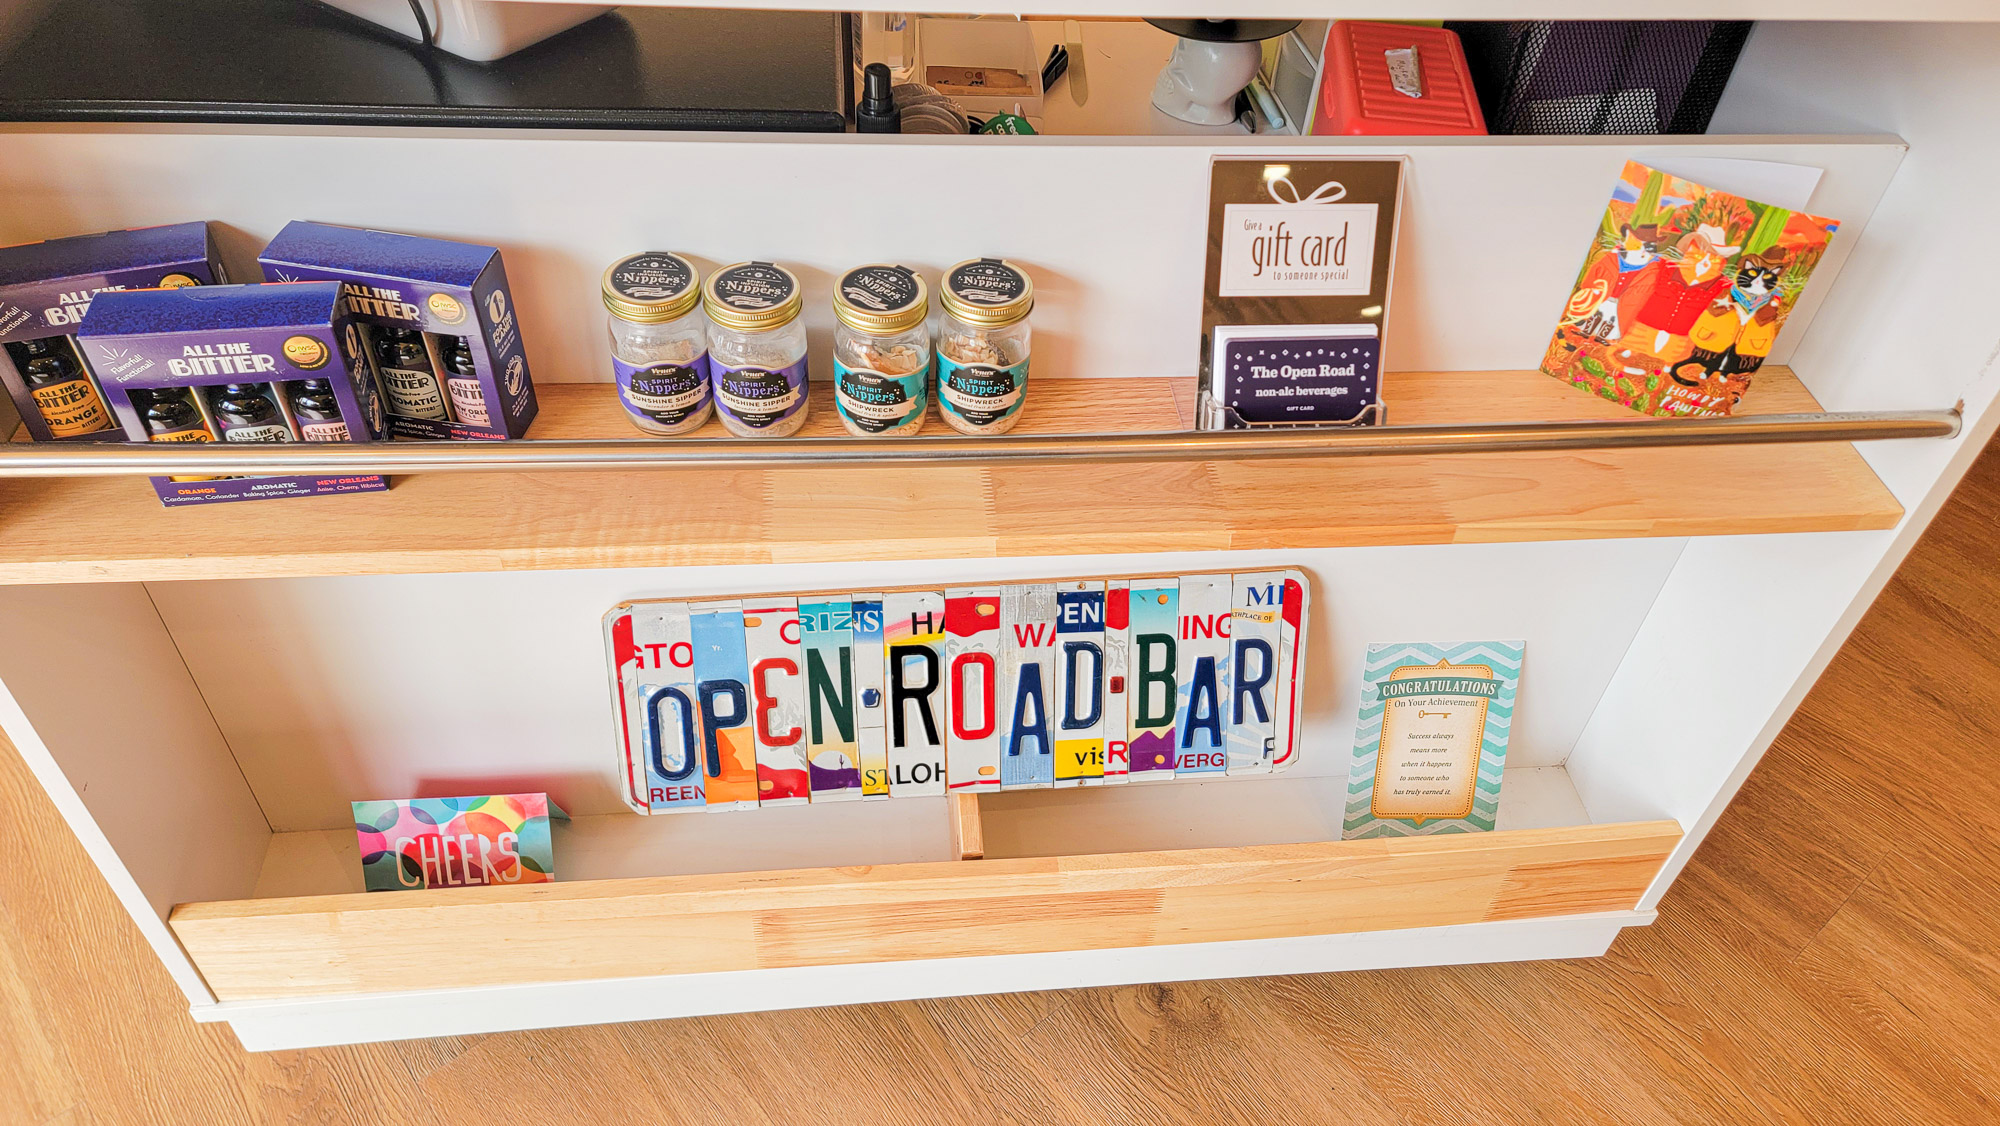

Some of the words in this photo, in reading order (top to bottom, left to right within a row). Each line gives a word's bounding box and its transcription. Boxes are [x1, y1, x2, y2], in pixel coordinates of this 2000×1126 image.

[1244, 219, 1258, 231] Give
[1252, 221, 1293, 277] gift
[1300, 221, 1349, 267] card
[622, 272, 680, 284] Nippers
[963, 275, 1011, 289] Nippers
[1273, 270, 1282, 281] to
[1284, 270, 1318, 281] someone
[1321, 268, 1349, 282] special
[344, 283, 372, 297] ALL
[371, 287, 402, 301] THE
[725, 280, 782, 295] Nippers
[859, 275, 901, 300] Nippers
[183, 345, 218, 357] ALL
[216, 342, 253, 355] THE
[110, 353, 144, 375] Flavorful!
[116, 358, 155, 383] Functional!
[167, 353, 276, 377] BITTER
[1250, 365, 1279, 379] The
[1280, 365, 1317, 380] Open
[1318, 363, 1356, 377] Road
[400, 372, 417, 380] THE
[651, 377, 678, 385] SPIRIT
[39, 390, 58, 398] ALL
[58, 382, 78, 395] THE
[637, 379, 692, 395] Nippers
[728, 379, 780, 398] Nippers
[846, 382, 896, 403] Nippers
[857, 384, 882, 394] SPIRIT
[956, 377, 1005, 396] Nippers
[1255, 386, 1294, 397] non-alc
[1295, 385, 1349, 398] beverages
[35, 385, 90, 409] BITTER
[631, 394, 674, 404] SUNSHINE
[675, 389, 702, 403] SIPPER
[722, 393, 760, 407] SUNSHINE
[762, 395, 791, 407] SIPPER
[956, 394, 1004, 405] SHIPWRECK
[1666, 385, 1726, 408] HOWDY
[847, 399, 895, 413] SHIPWRECK
[46, 405, 98, 426] ORANGE
[235, 430, 254, 438] ALL
[253, 427, 273, 437] THE
[177, 487, 217, 495] ORANGE
[251, 482, 298, 491] AROMATIC
[339, 475, 380, 484] ORLEANS
[1382, 679, 1498, 697] CONGRATULATIONS
[646, 646, 856, 781] OPEN
[890, 640, 1104, 757] ROAD
[1135, 632, 1274, 749] BAR
[1394, 699, 1406, 708] On
[1407, 697, 1427, 708] Your
[1428, 697, 1479, 708] Achievement
[1407, 732, 1432, 740] Success
[1432, 732, 1455, 741] always
[1401, 760, 1419, 768] when
[1426, 760, 1452, 769] happens
[1393, 788, 1404, 796] has
[1405, 788, 1421, 797] truly
[1422, 788, 1442, 796] earned
[395, 831, 522, 890] CHEERS
